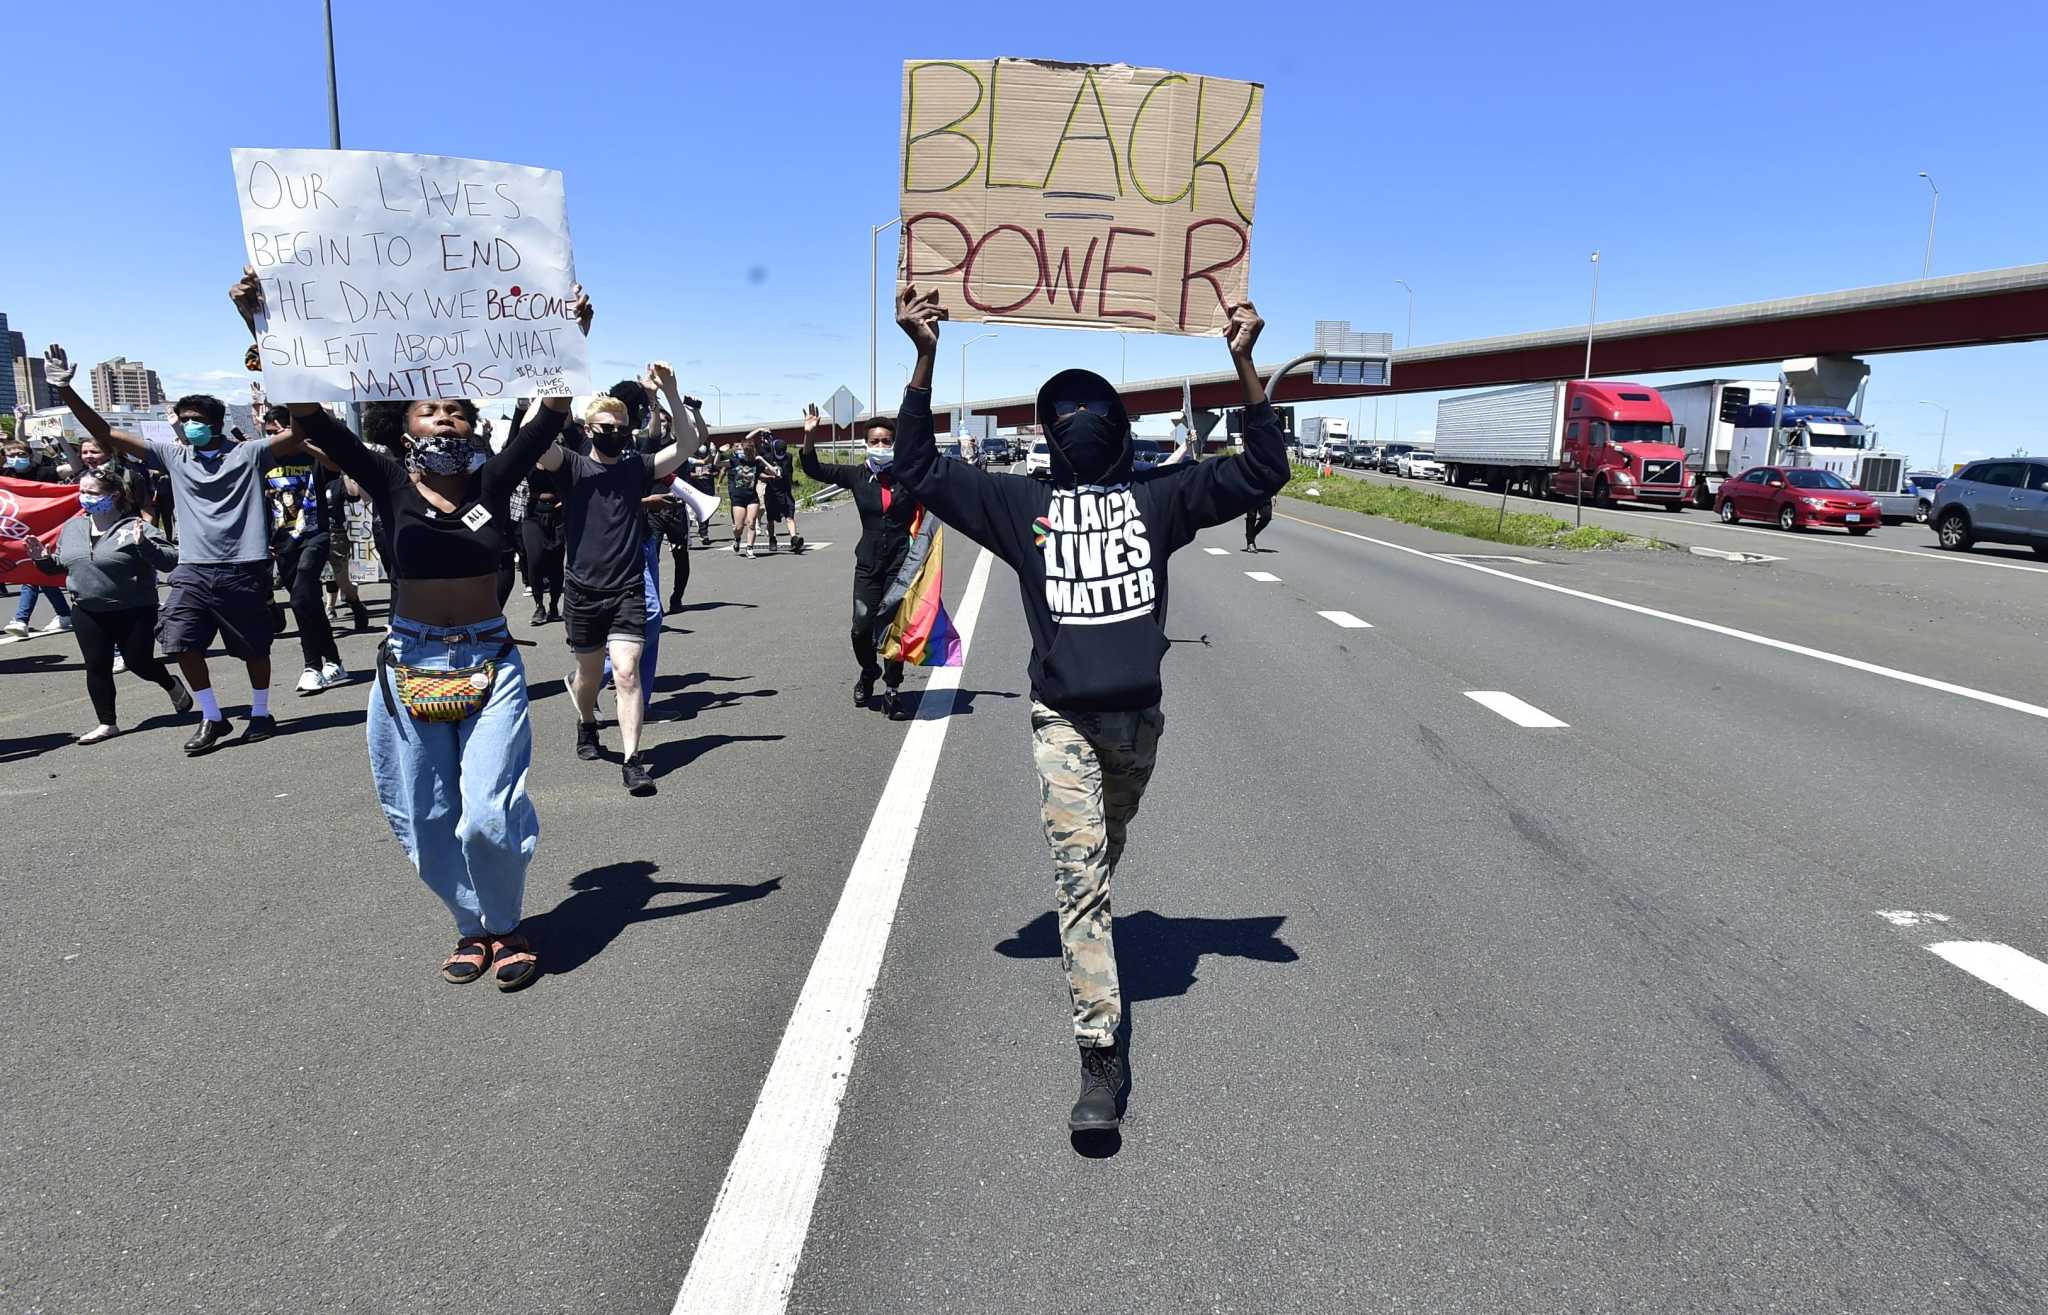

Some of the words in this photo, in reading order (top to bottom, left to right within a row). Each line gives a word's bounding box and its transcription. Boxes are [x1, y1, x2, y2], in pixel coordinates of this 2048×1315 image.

[903, 57, 1254, 226] BLACK
[249, 160, 339, 210] OUR
[375, 166, 522, 219] LIVES
[251, 231, 350, 267] BEGIN
[362, 231, 412, 267] TO
[440, 233, 522, 272] END
[905, 210, 1249, 331] POWER
[257, 277, 328, 323] THE
[339, 280, 414, 324] DAY
[423, 288, 479, 319] WE
[486, 288, 577, 321] BECOME
[261, 332, 378, 368] SILENT
[394, 328, 471, 363] ABOUT
[484, 327, 562, 360] WHAT
[349, 361, 504, 401] MATTERS
[535, 377, 565, 389] LIVES
[536, 386, 573, 396] MATTER
[1047, 490, 1142, 533] BLACK
[1043, 519, 1152, 580] LIVES
[1045, 568, 1156, 614] MATTER
